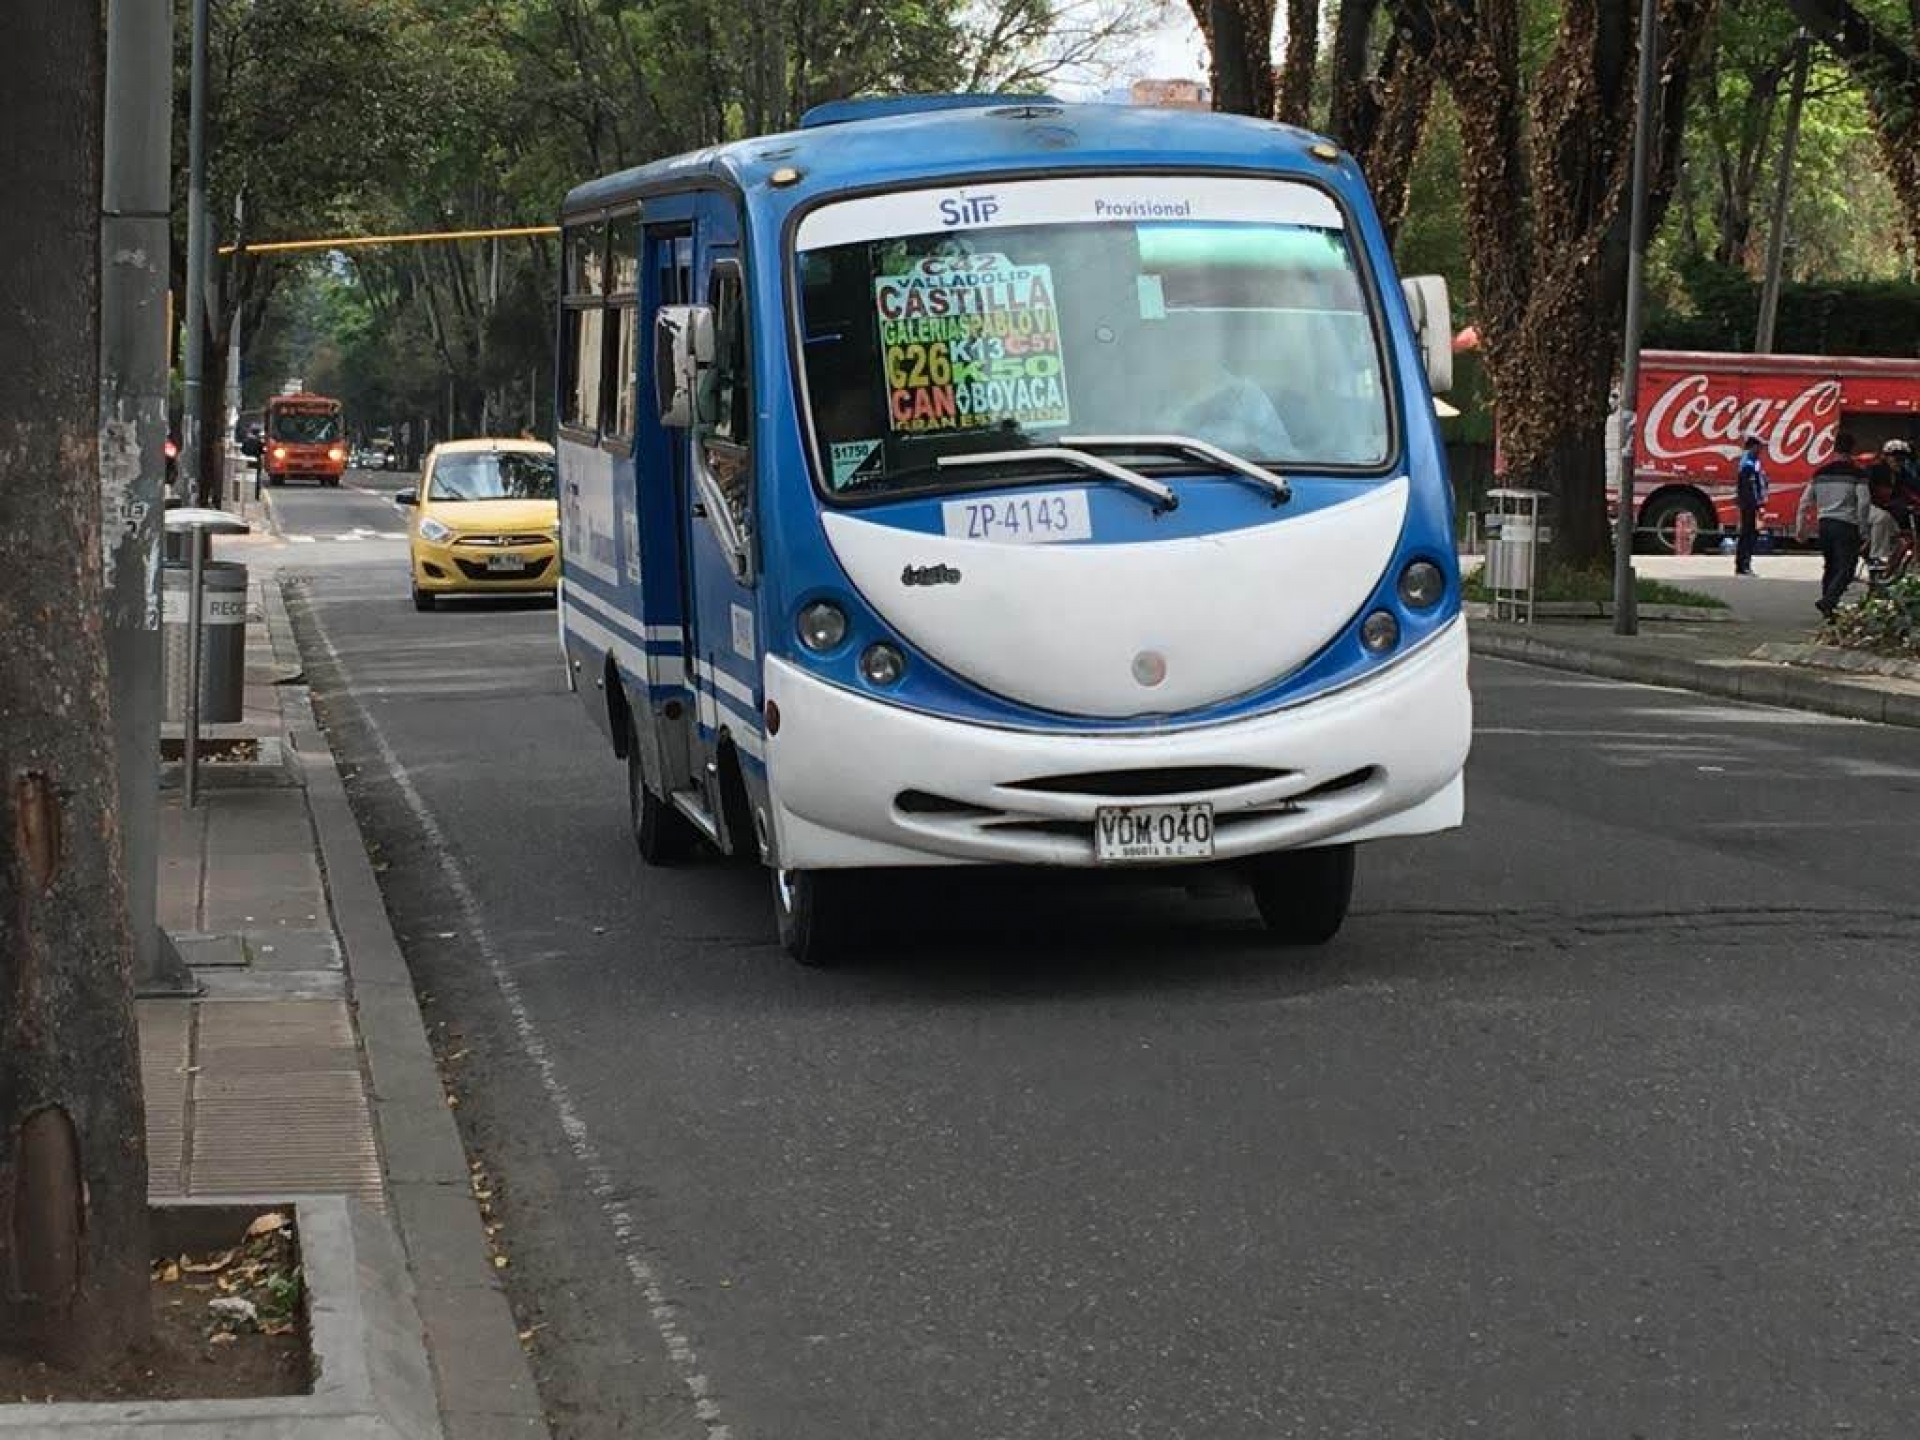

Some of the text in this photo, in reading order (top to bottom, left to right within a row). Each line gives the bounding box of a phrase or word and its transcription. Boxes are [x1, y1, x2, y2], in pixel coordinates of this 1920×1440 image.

[1094, 199, 1191, 217] Provisional
[879, 276, 1050, 320] CASTILLA
[884, 314, 969, 345] GALERIAS
[888, 343, 950, 389] C26
[951, 337, 1006, 362] K13
[952, 355, 1060, 384] K50
[892, 384, 956, 421] CAN
[971, 376, 1062, 413] BOYACA
[964, 497, 1068, 539] ZP-4143
